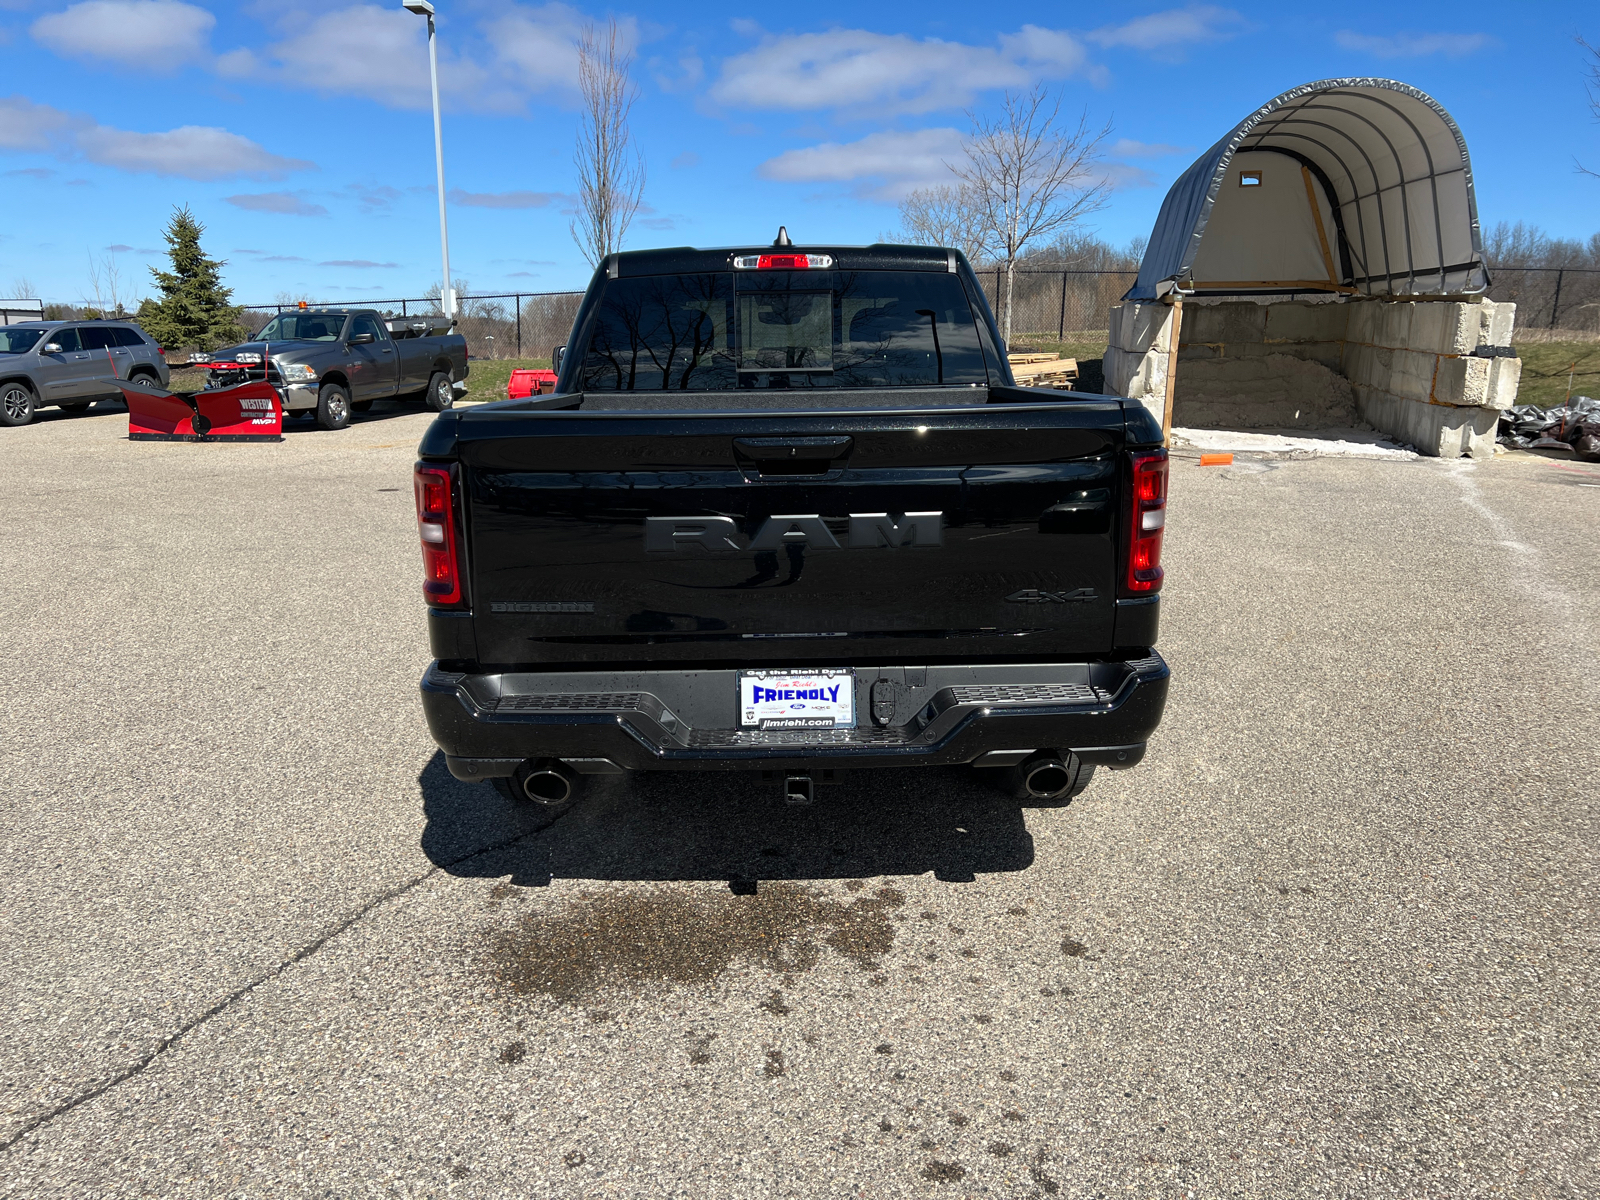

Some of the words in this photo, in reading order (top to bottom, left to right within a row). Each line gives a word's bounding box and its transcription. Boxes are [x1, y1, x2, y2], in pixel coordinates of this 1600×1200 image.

[239, 399, 273, 410] WESTERN
[645, 511, 944, 553] RAM
[775, 681, 790, 690] Jim
[753, 684, 840, 704] FRIENDLY
[763, 719, 833, 729] jimriehl.com
